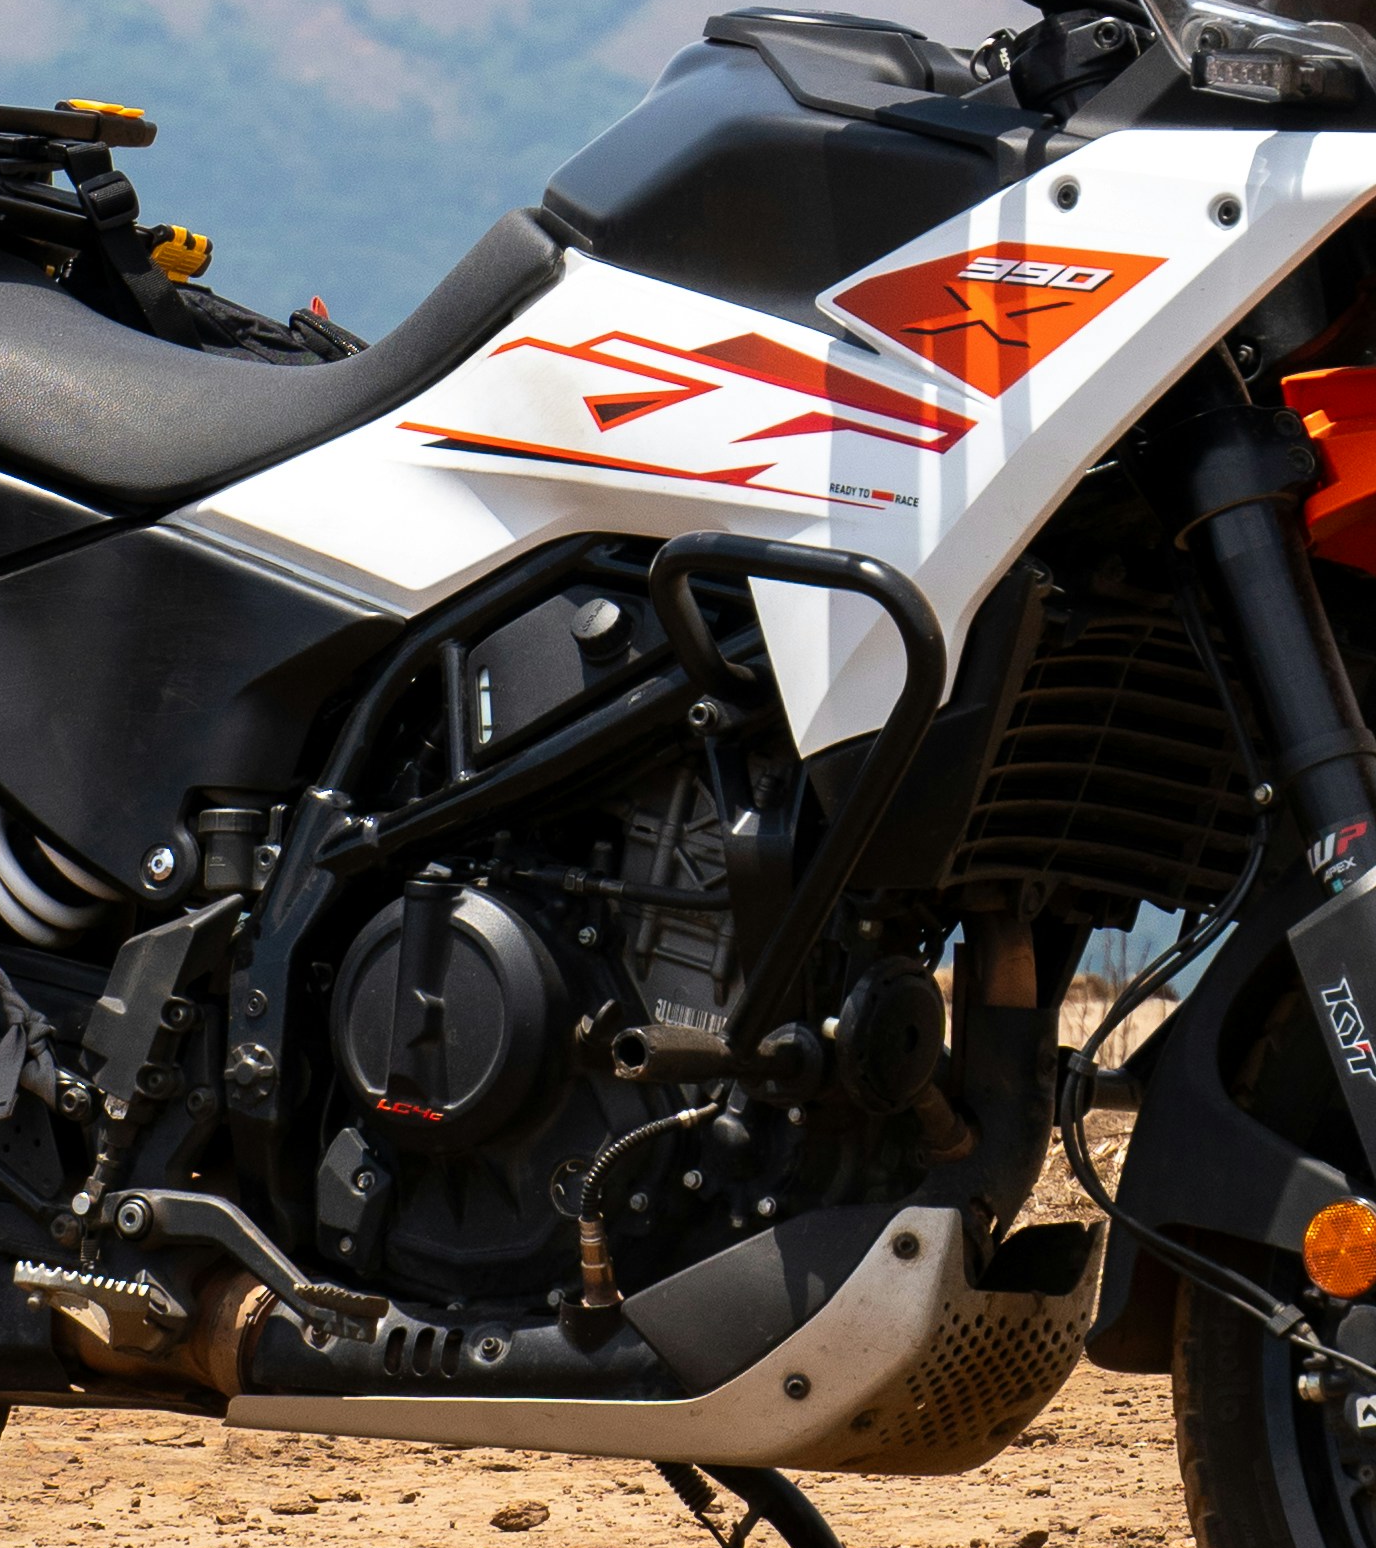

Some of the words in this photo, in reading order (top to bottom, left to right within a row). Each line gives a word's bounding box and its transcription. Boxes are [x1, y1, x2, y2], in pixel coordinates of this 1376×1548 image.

[957, 256, 1115, 293] 390
[828, 481, 858, 497] READY
[858, 486, 871, 499] TO
[894, 493, 920, 508] RACE
[1307, 820, 1368, 876] WP
